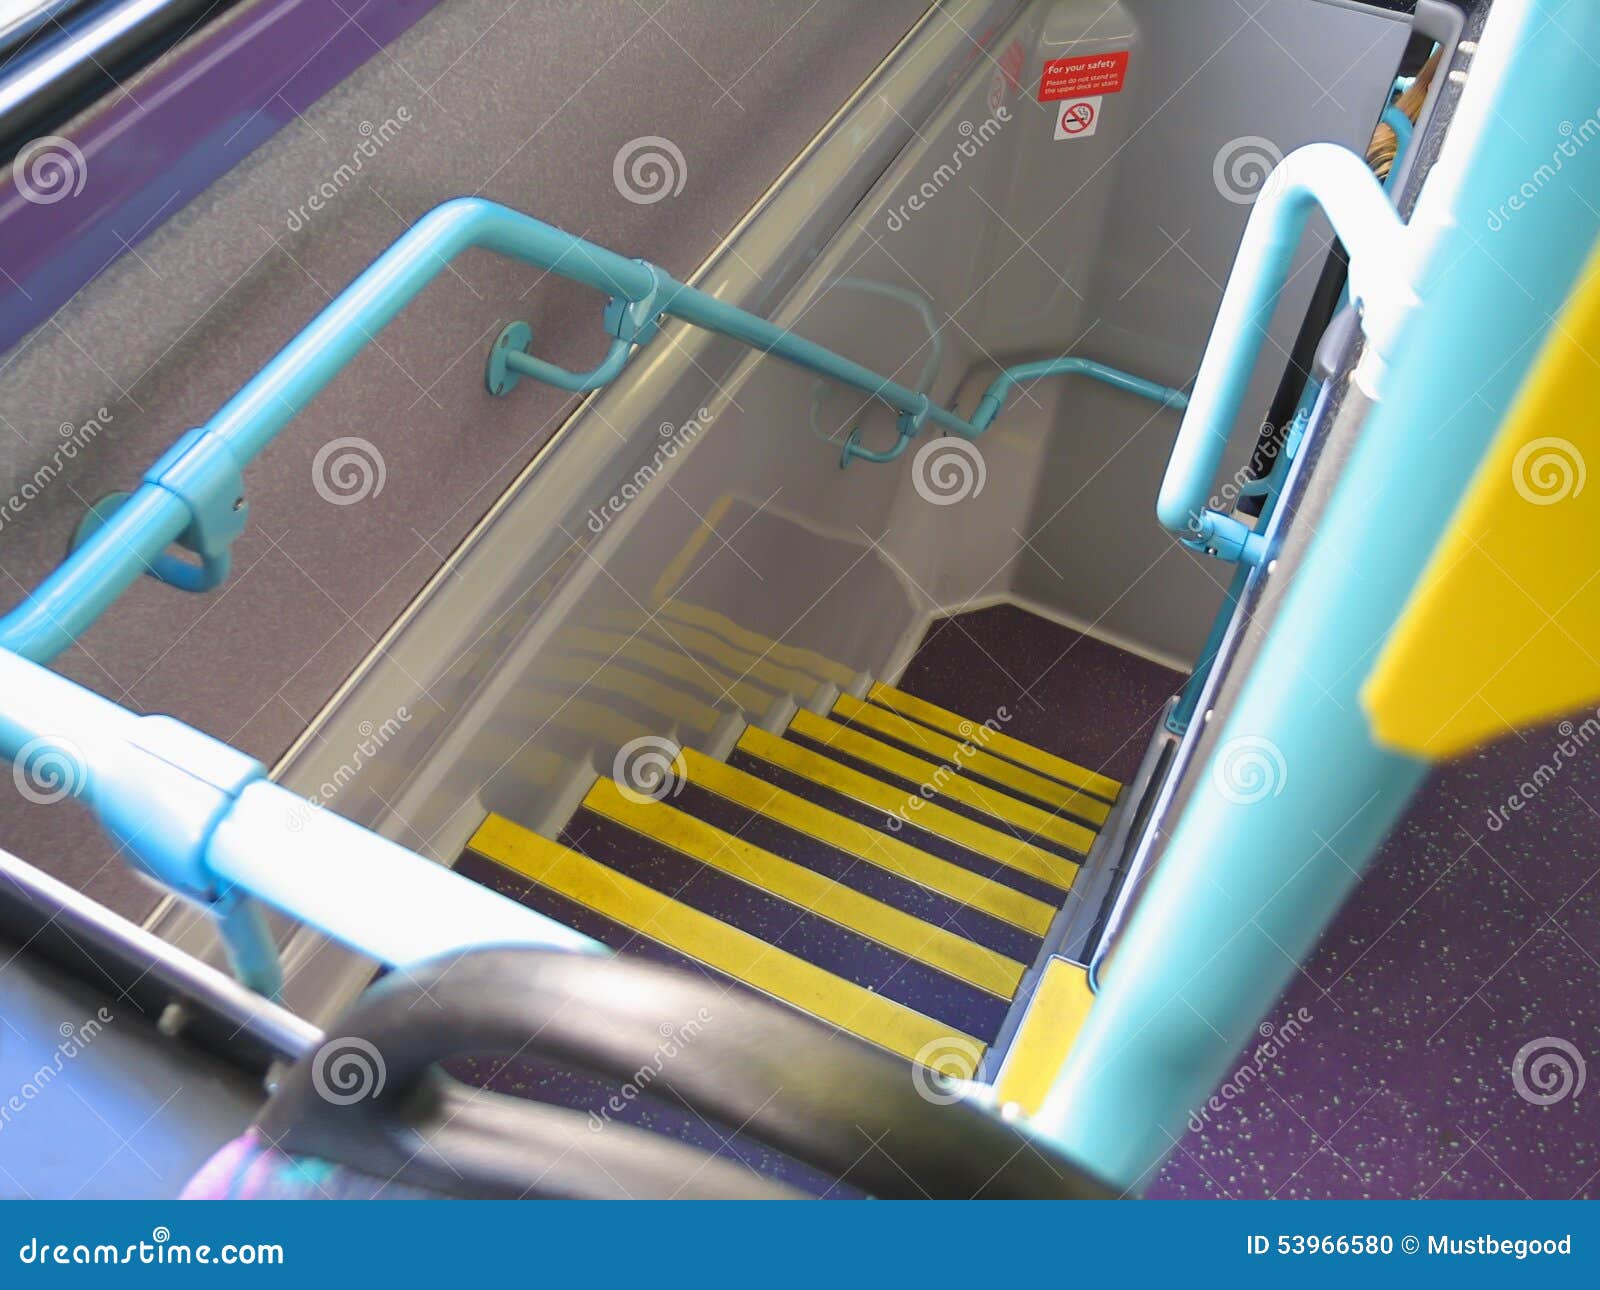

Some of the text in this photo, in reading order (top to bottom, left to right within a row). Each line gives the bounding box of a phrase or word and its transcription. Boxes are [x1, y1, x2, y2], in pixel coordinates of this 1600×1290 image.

[1048, 60, 1116, 75] For your safety
[1045, 87, 1056, 95] the
[1057, 85, 1076, 93] upper
[1101, 80, 1119, 88] stairs
[1046, 78, 1067, 86] Please
